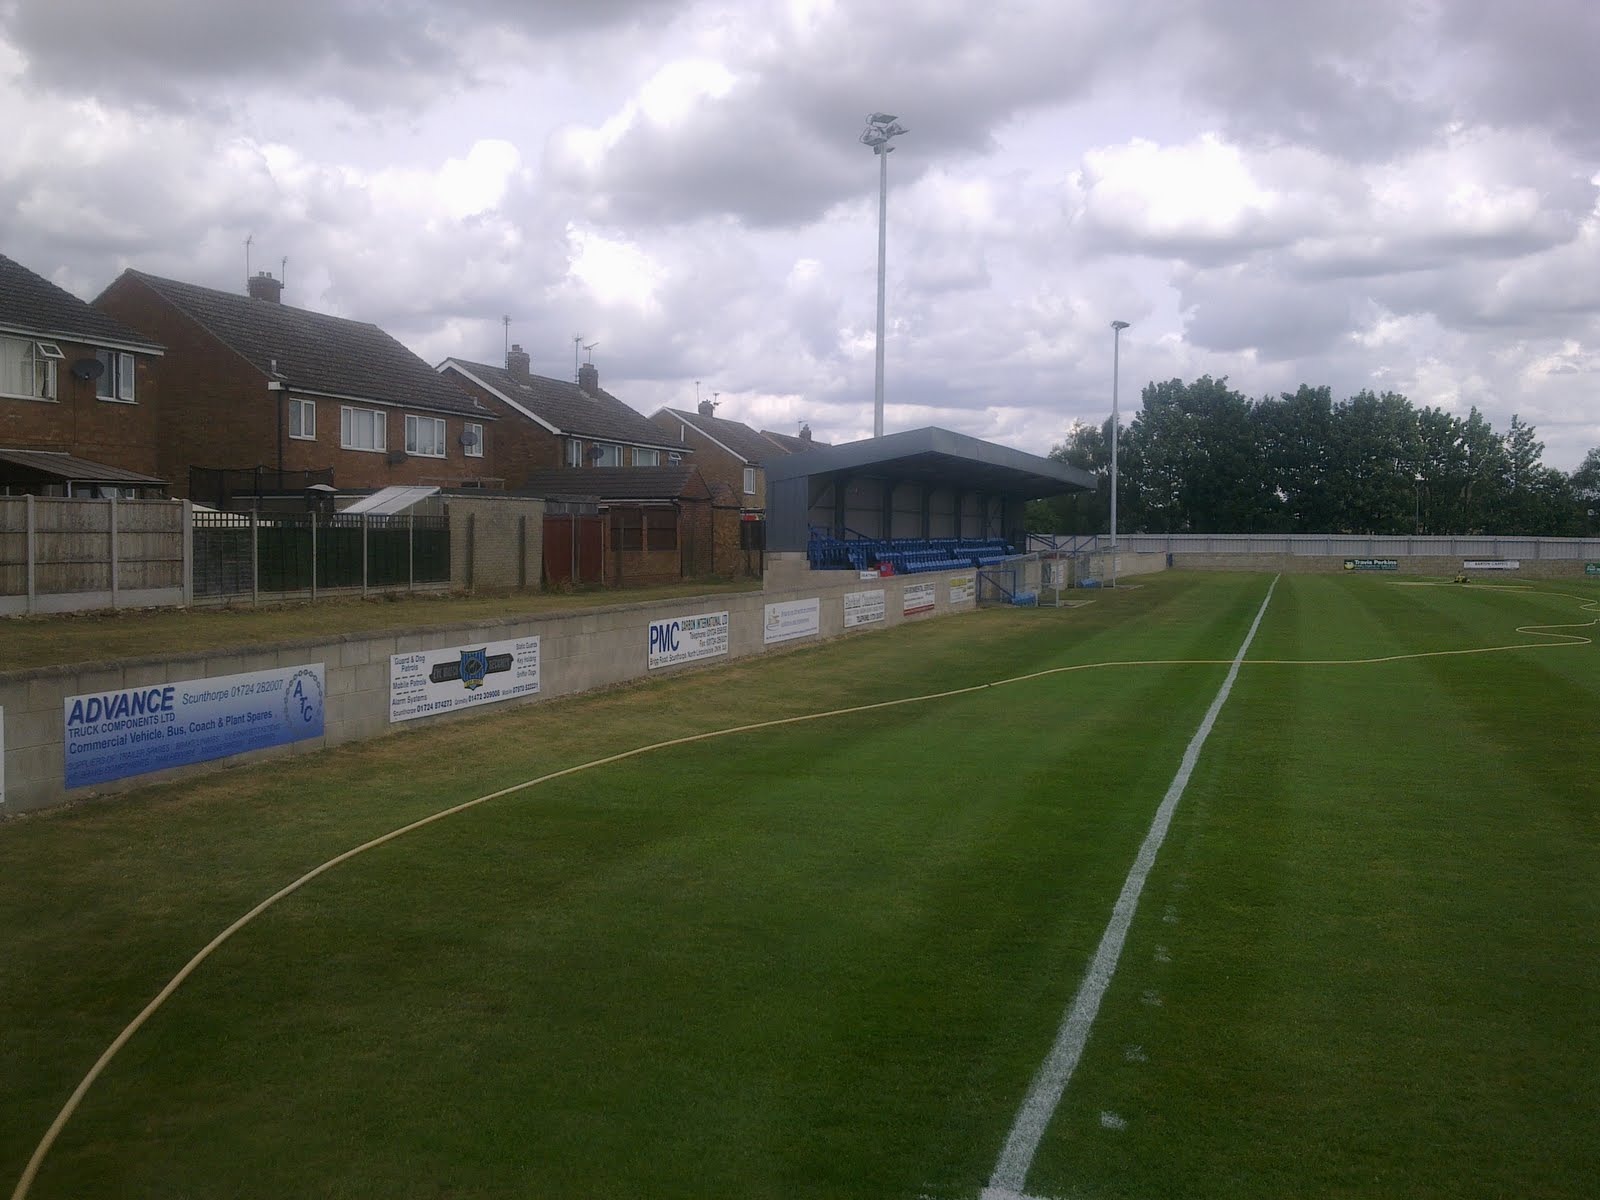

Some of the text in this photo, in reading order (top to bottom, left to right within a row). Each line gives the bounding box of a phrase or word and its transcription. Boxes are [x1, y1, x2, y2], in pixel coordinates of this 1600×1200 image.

[650, 621, 680, 654] PMC
[67, 686, 175, 726] ADVANCE
[182, 690, 229, 706] Scunthorpe
[231, 683, 255, 697] 01724
[417, 703, 433, 712] 01724
[68, 712, 175, 738] TRUCK COMPONENTS LTD
[69, 734, 127, 754] Commercial
[189, 720, 216, 733] Coach
[218, 717, 224, 728] &
[225, 713, 245, 726] Plant
[247, 710, 273, 724] Spares
